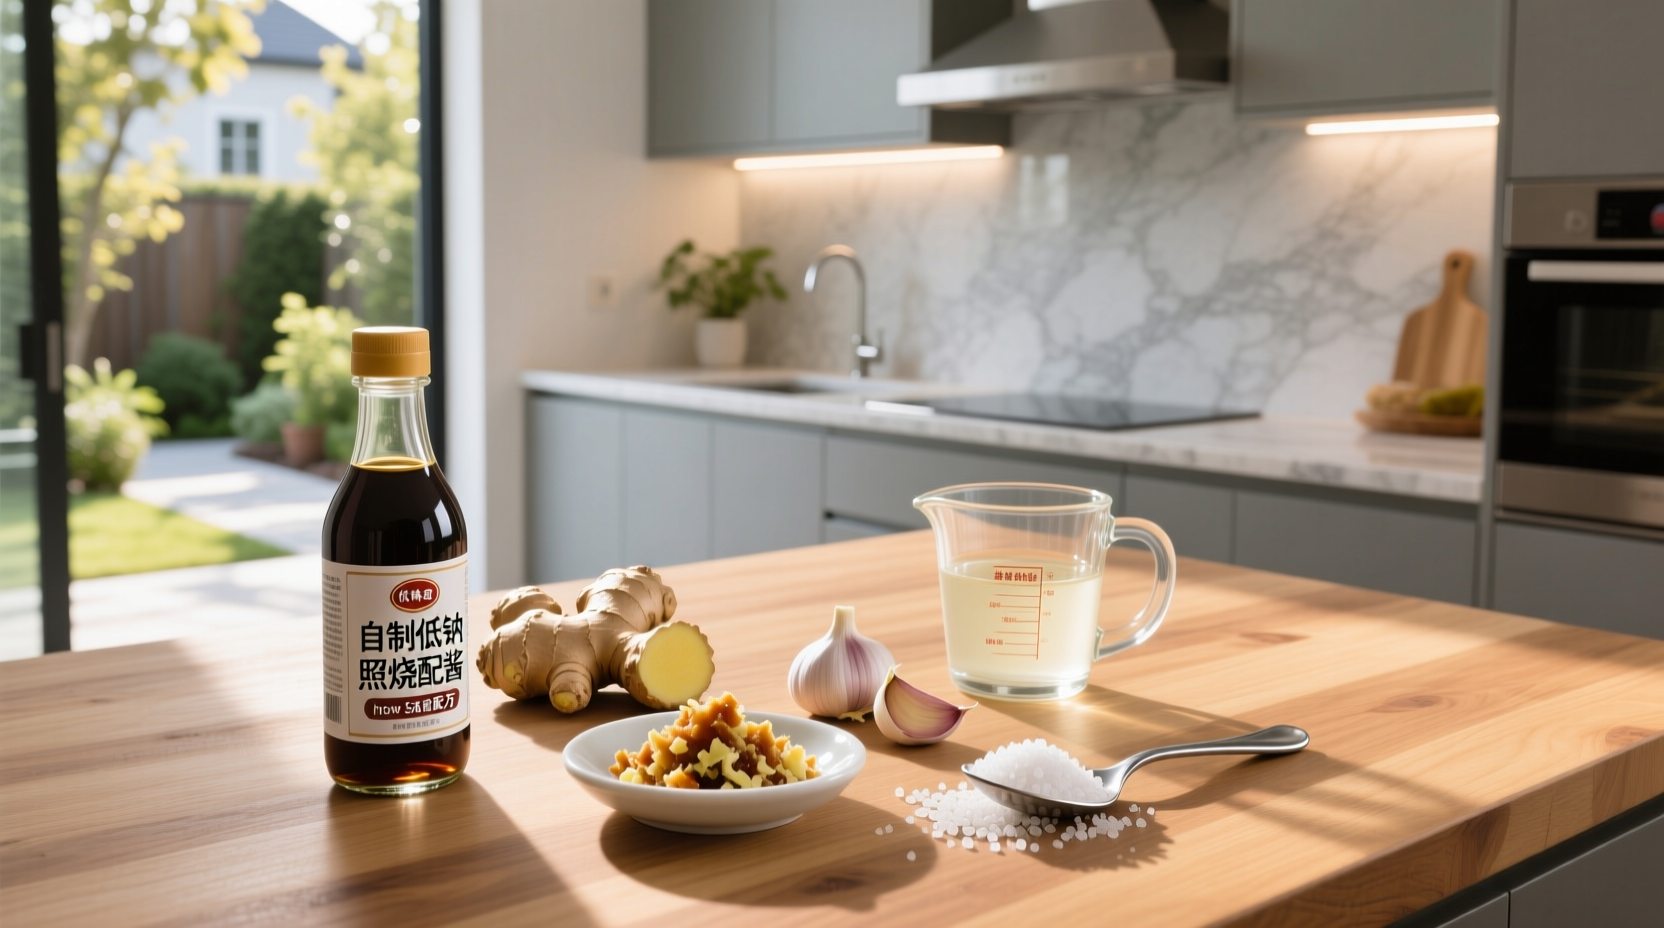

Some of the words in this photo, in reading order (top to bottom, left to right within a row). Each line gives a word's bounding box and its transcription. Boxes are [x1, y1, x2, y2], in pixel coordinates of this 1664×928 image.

[361, 611, 463, 653] 自制低钠
[358, 649, 464, 690] 照烧配酱
